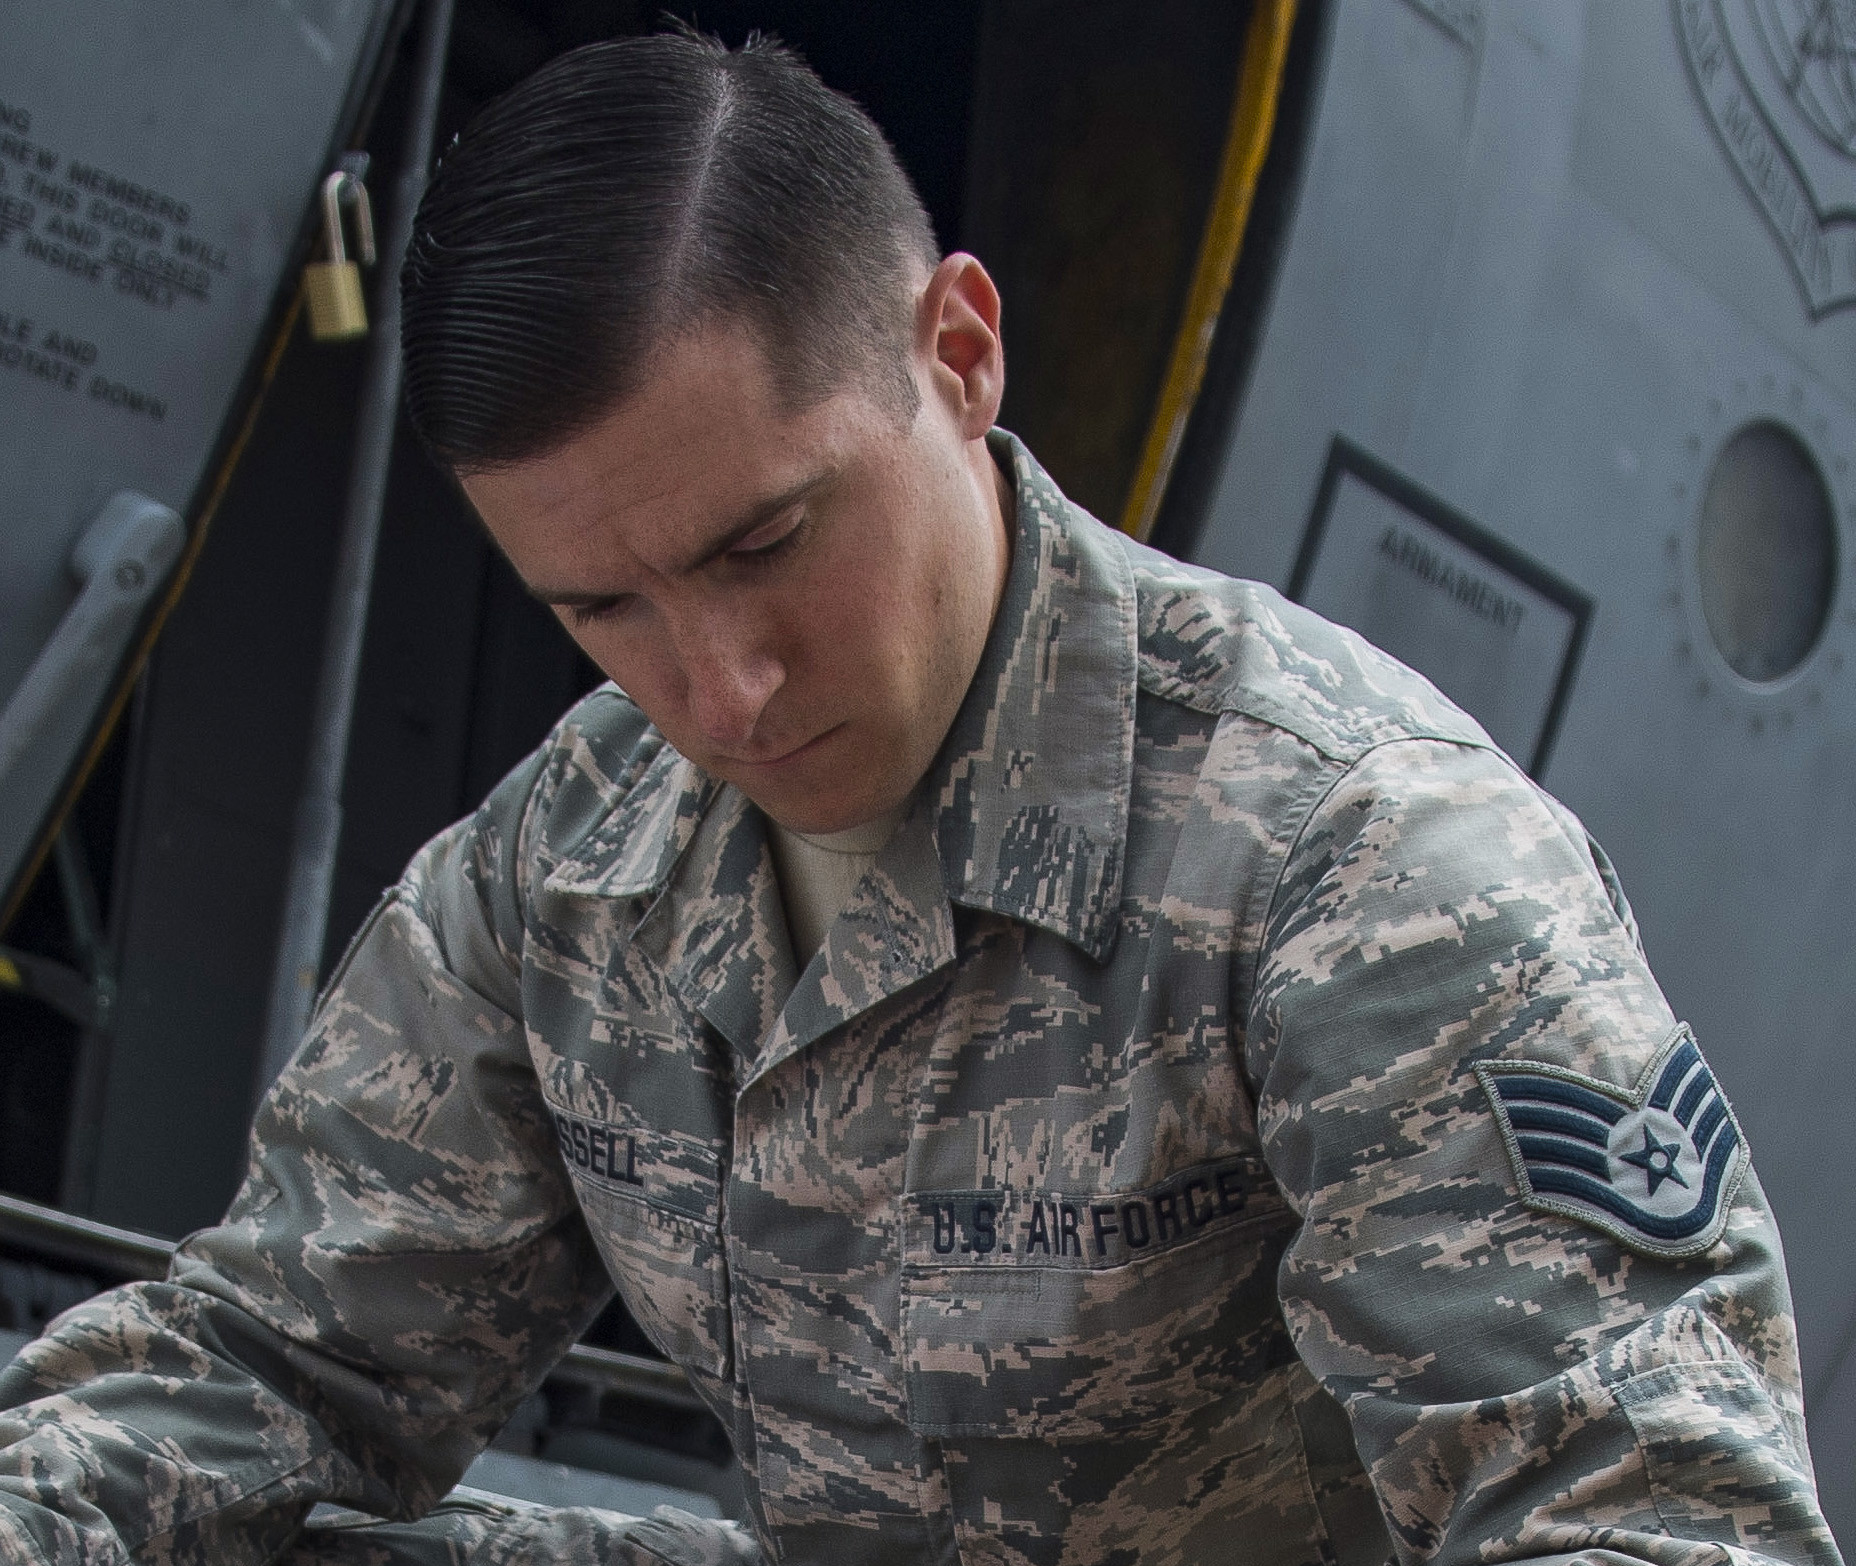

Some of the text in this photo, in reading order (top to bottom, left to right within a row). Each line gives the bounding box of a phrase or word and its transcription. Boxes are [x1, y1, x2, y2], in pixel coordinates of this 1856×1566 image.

[24, 172, 81, 213] THIS
[87, 198, 165, 243] DOOR
[173, 234, 229, 275] WILL
[66, 161, 191, 227] MEMBERS
[21, 235, 103, 282] INSIDE
[113, 267, 176, 311] ONLY
[44, 215, 101, 249] AND
[107, 237, 211, 294] CLOSED
[41, 329, 99, 369] AND
[88, 376, 168, 423] DOWN
[1379, 527, 1525, 634] ARMAMENT
[932, 1167, 1244, 1257] U.S. AIR FORCE
